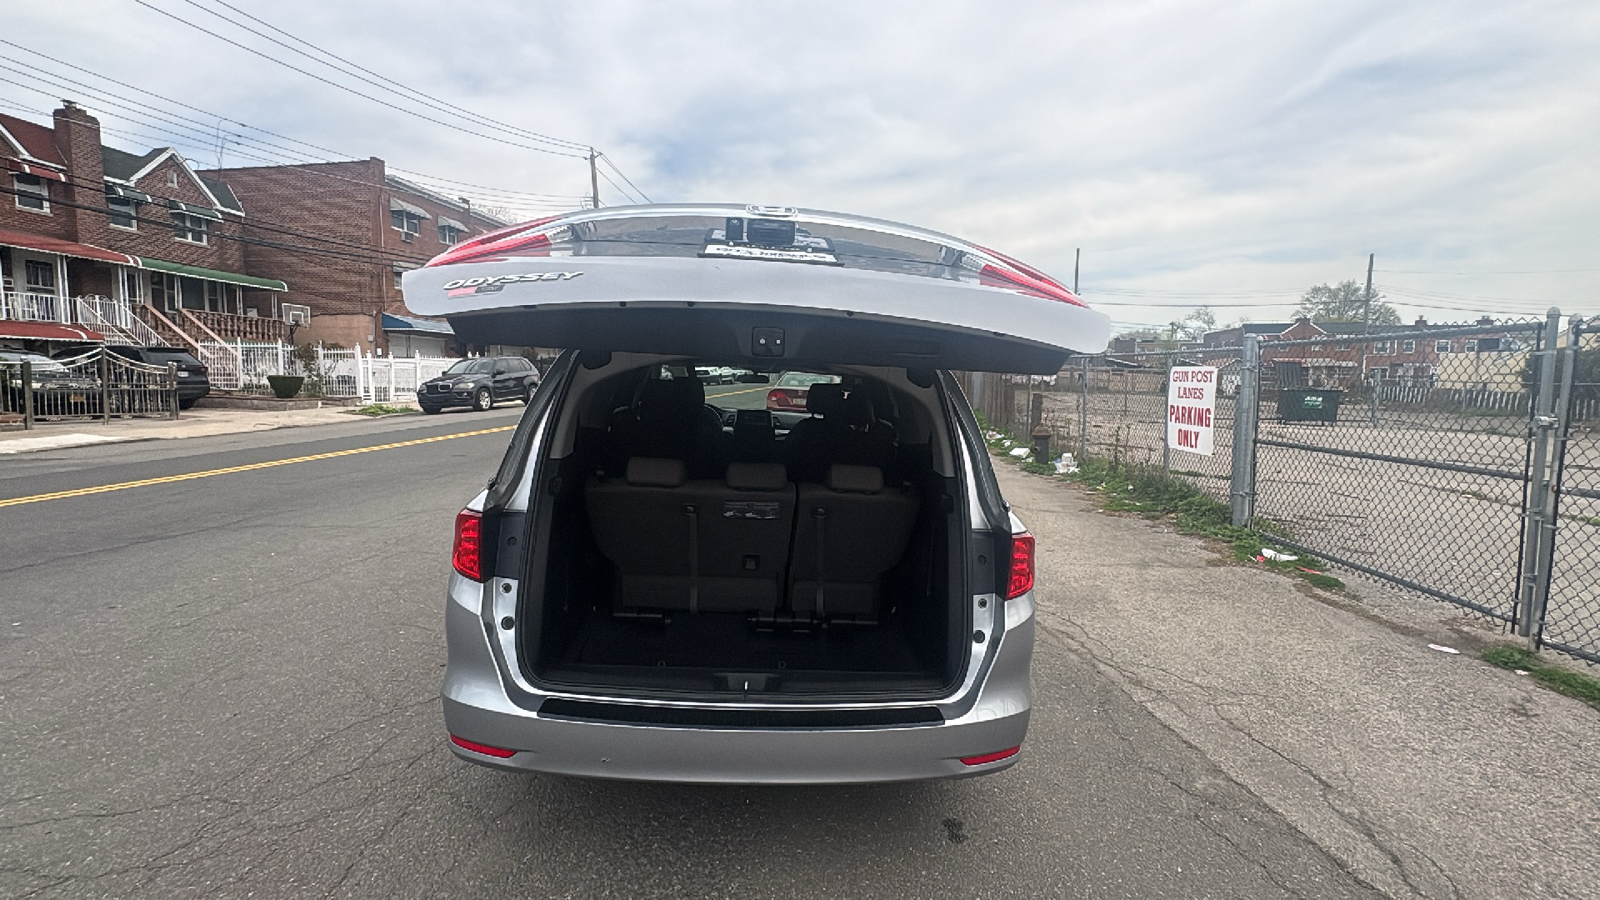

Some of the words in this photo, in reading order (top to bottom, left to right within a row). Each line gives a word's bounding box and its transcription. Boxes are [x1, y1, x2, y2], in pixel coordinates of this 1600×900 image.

[443, 271, 584, 290] ODYSSEY
[1172, 370, 1189, 382] GUN
[1191, 370, 1214, 383] POST
[1177, 386, 1204, 400] LANES
[1169, 404, 1212, 428] PARKING
[1177, 428, 1200, 449] ONLY
